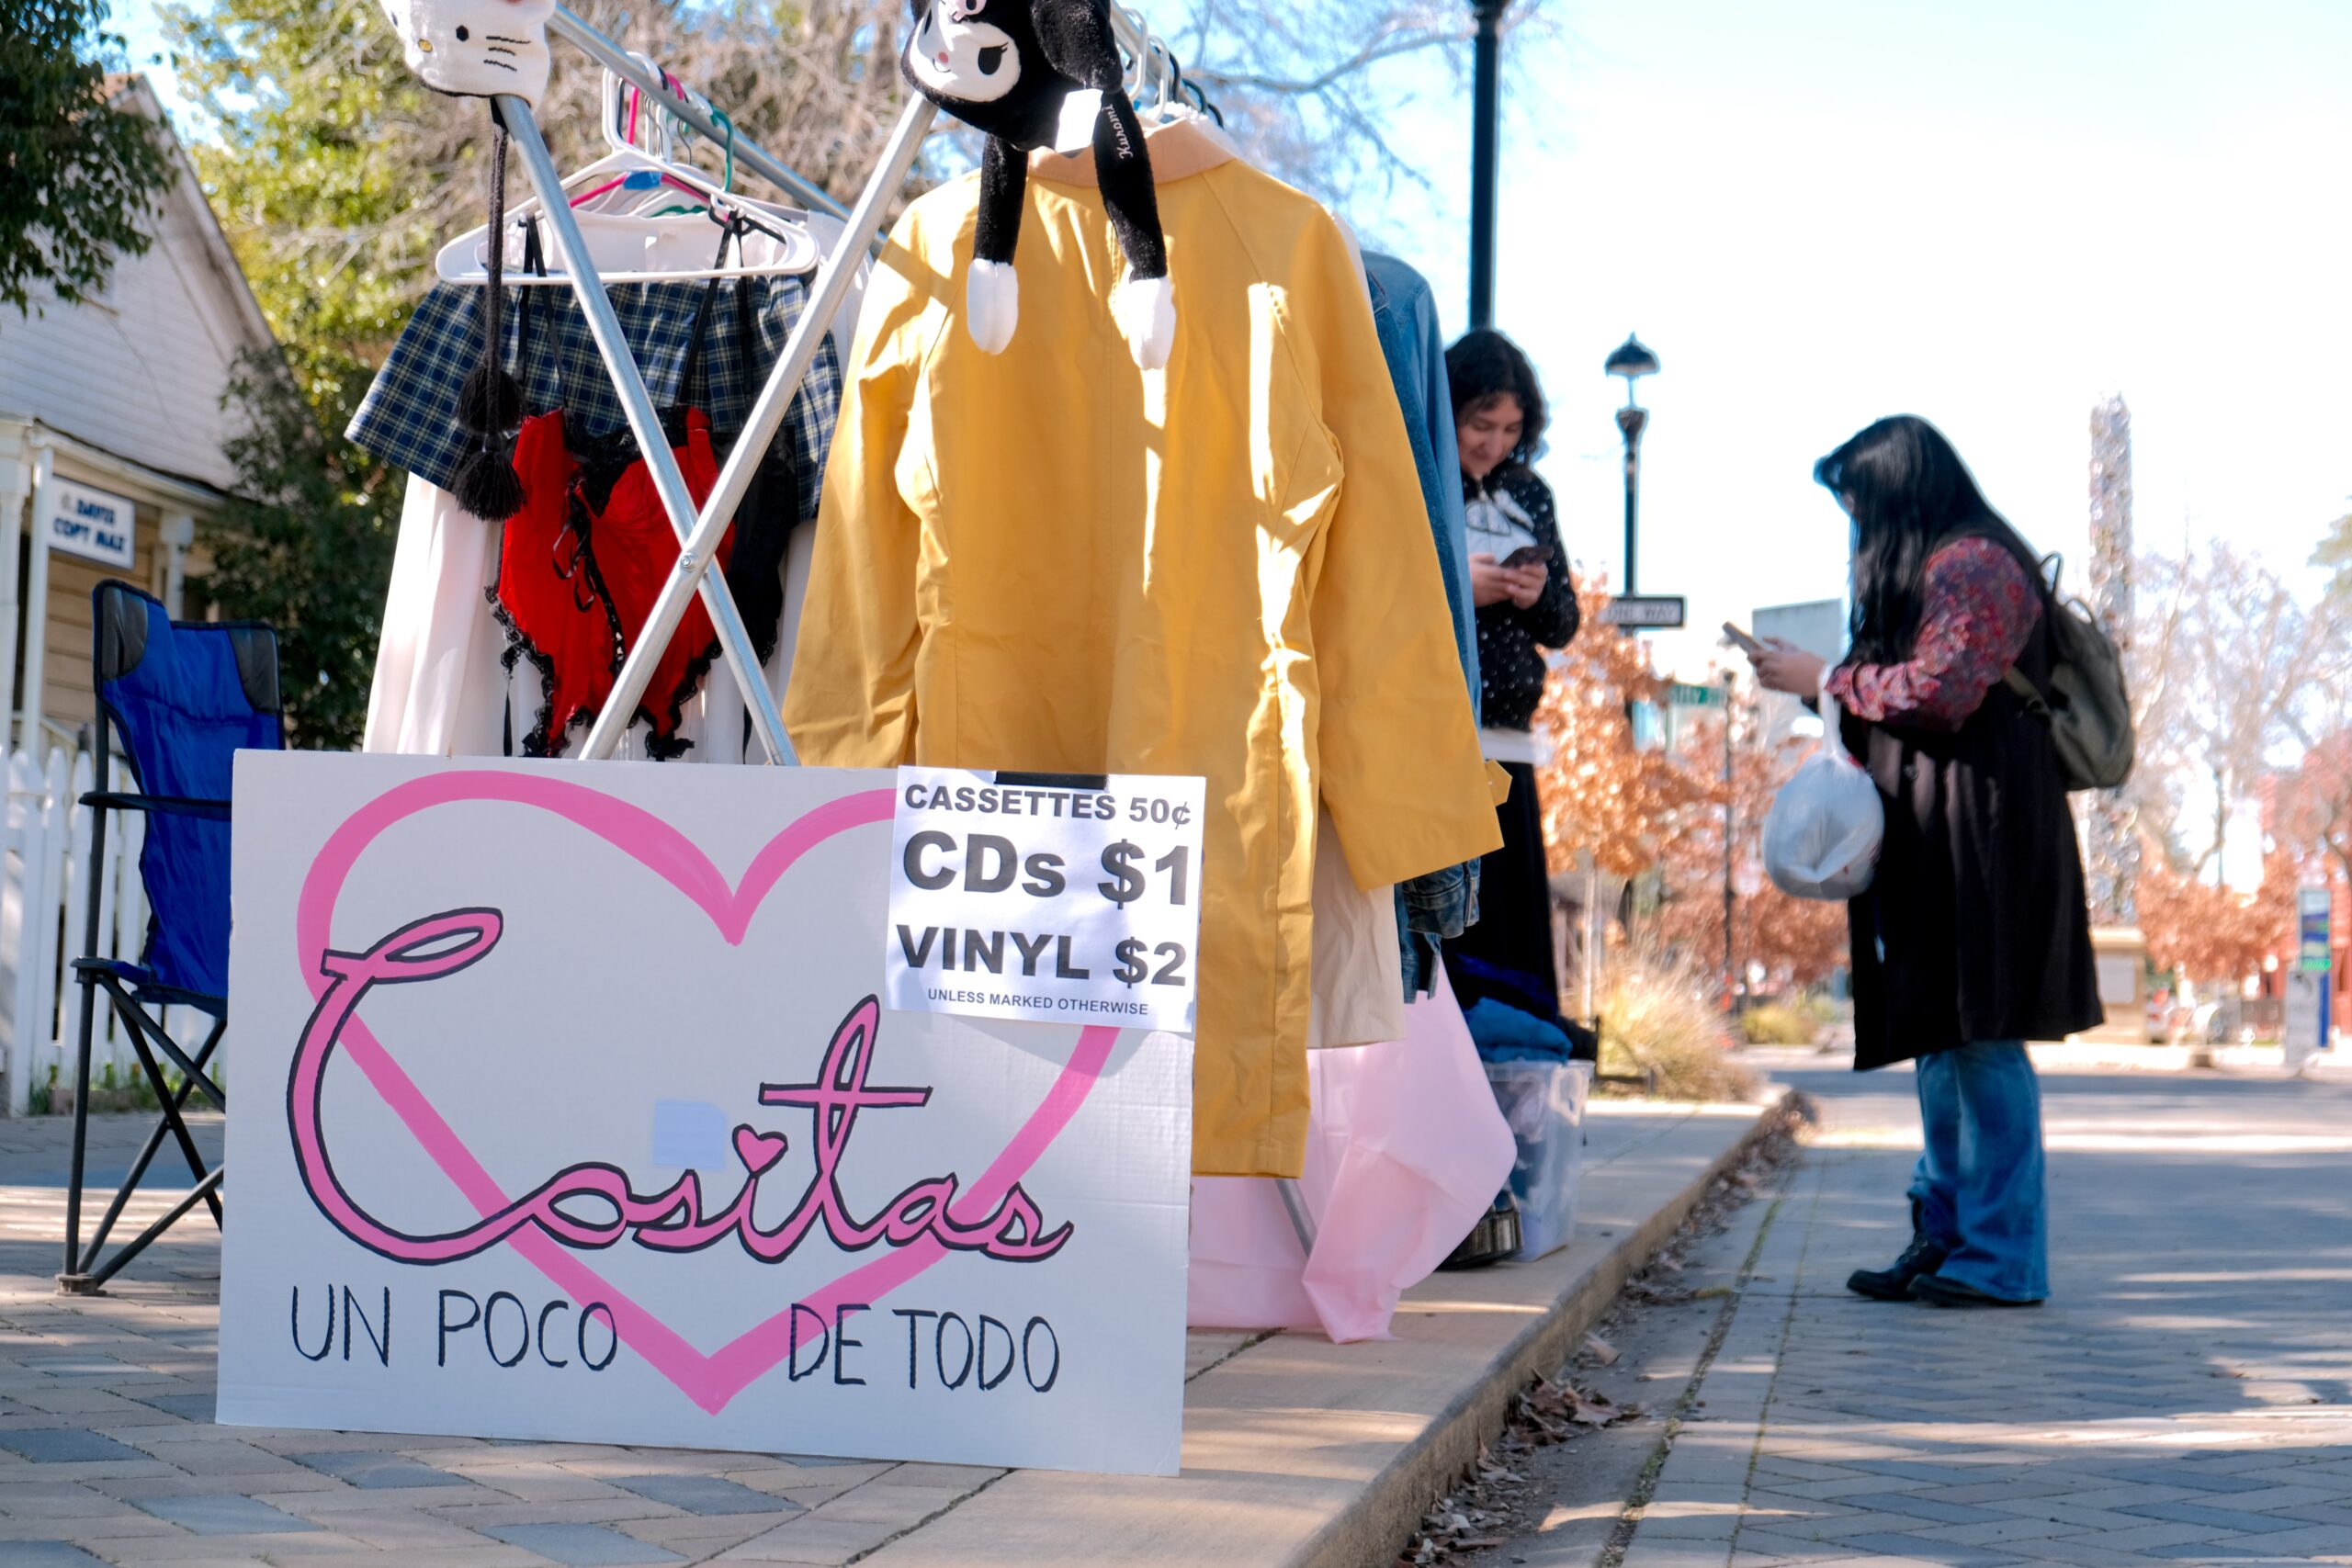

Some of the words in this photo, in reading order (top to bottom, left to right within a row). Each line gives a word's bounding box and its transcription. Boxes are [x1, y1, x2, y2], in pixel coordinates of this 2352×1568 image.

[1102, 104, 1133, 160] Kuromi
[53, 517, 91, 544] COPY
[77, 499, 115, 525] DAVIS
[1645, 604, 1675, 620] WAY
[905, 784, 1116, 820] CASSETTES
[1129, 797, 1192, 829] 50¢
[903, 830, 1066, 897] CDs
[1097, 839, 1190, 909] $1
[896, 924, 1091, 980] VINYL
[1113, 937, 1186, 988] $2
[928, 988, 985, 1004] UNLESS
[989, 993, 1053, 1010] MARKED
[1057, 998, 1148, 1016] OTHERWISE
[287, 908, 1073, 1264] Cositas
[290, 1283, 390, 1368] UN
[438, 1289, 618, 1371] POCO
[788, 1303, 872, 1386] DE
[892, 1308, 1060, 1393] TODO
